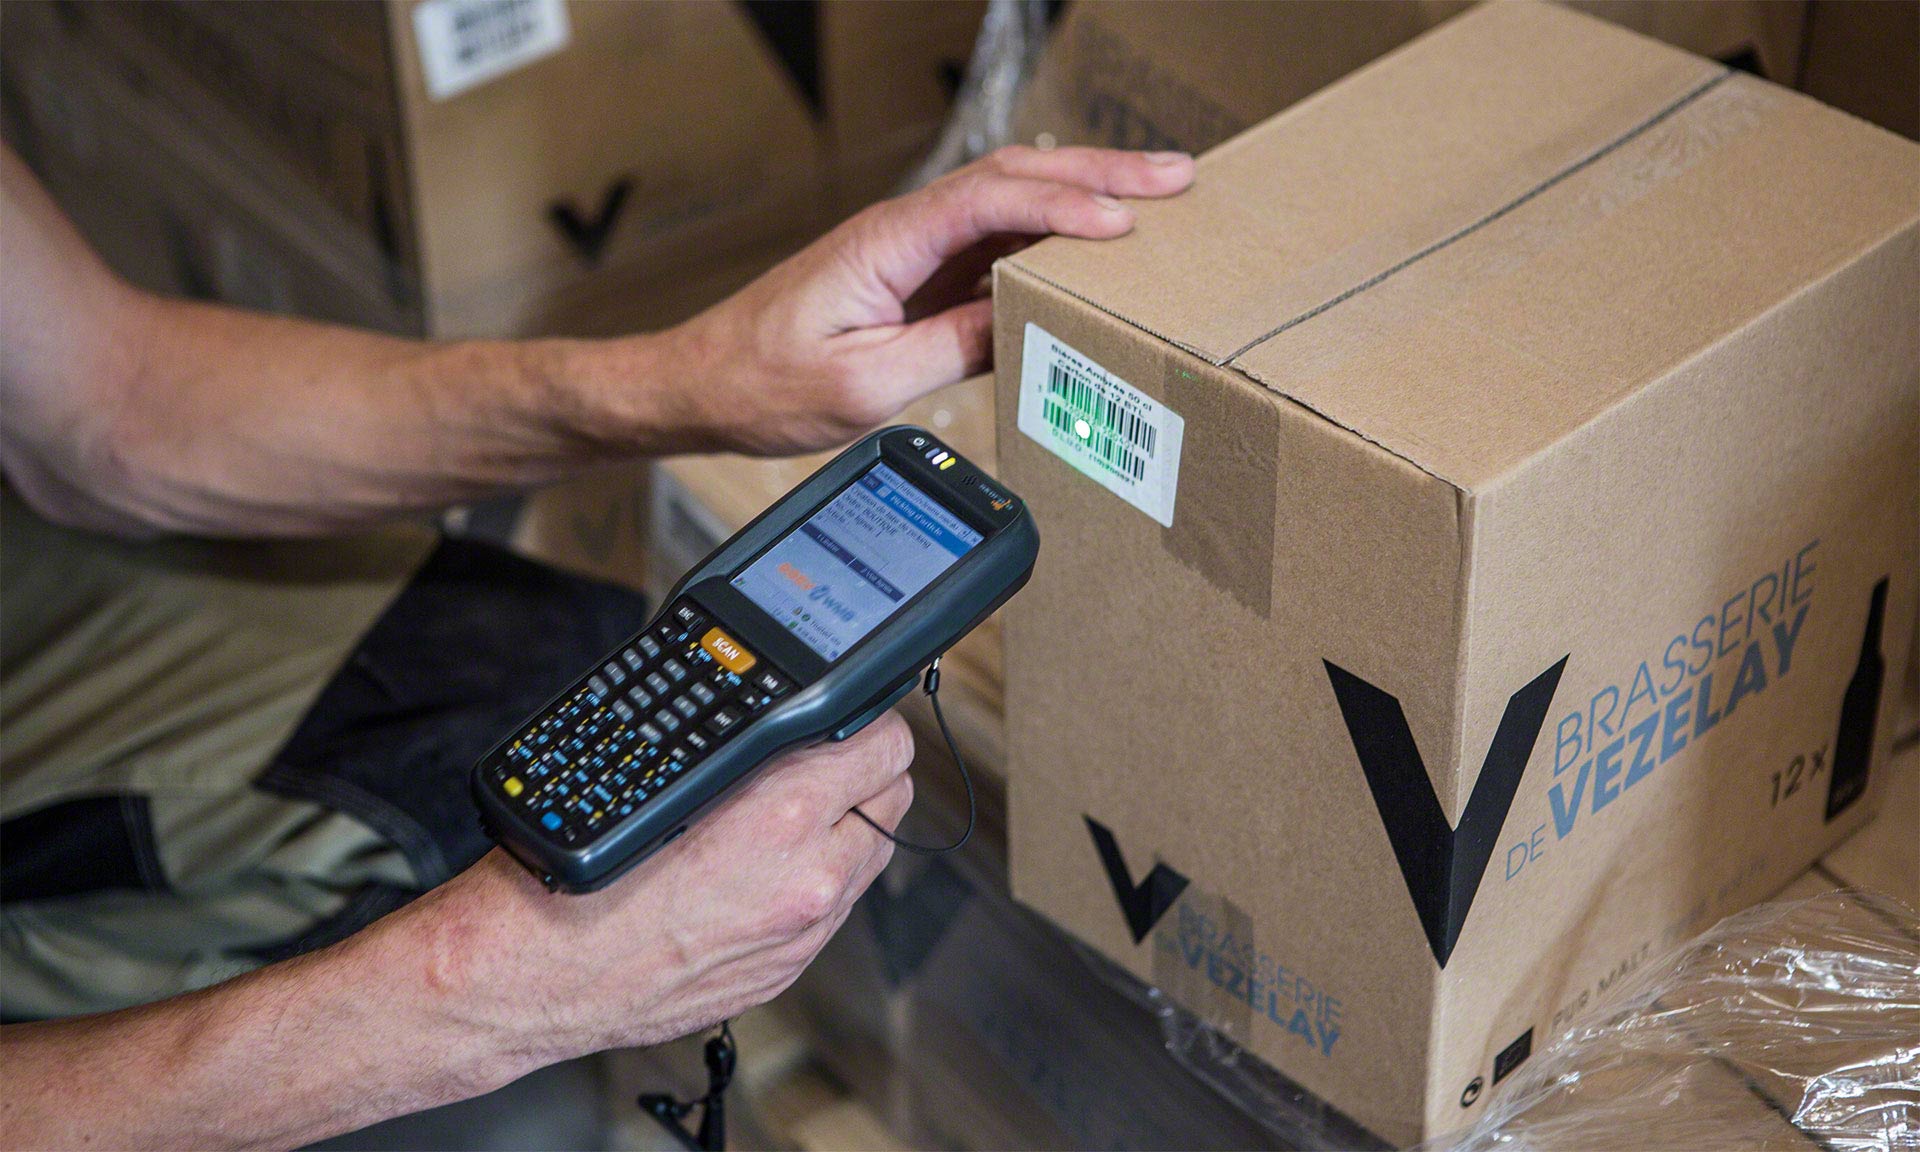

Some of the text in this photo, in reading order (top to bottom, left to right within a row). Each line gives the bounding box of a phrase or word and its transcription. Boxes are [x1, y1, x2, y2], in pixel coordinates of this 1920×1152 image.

[1058, 359, 1145, 417] Carton de 12 BTL
[1128, 392, 1139, 403] 50
[862, 509, 896, 535] BOUTIQUE
[888, 496, 915, 516] Picking
[915, 514, 942, 536] d'article
[906, 529, 931, 548] picking
[678, 607, 693, 619] ESC
[712, 637, 740, 659] SCAN
[1554, 540, 1820, 777] BRASSERIE
[761, 675, 778, 688] TAB
[1505, 603, 1811, 882] DE VEZELAY
[1179, 903, 1343, 1023] BRASSERIE
[1181, 932, 1340, 1057] VEZELAY
